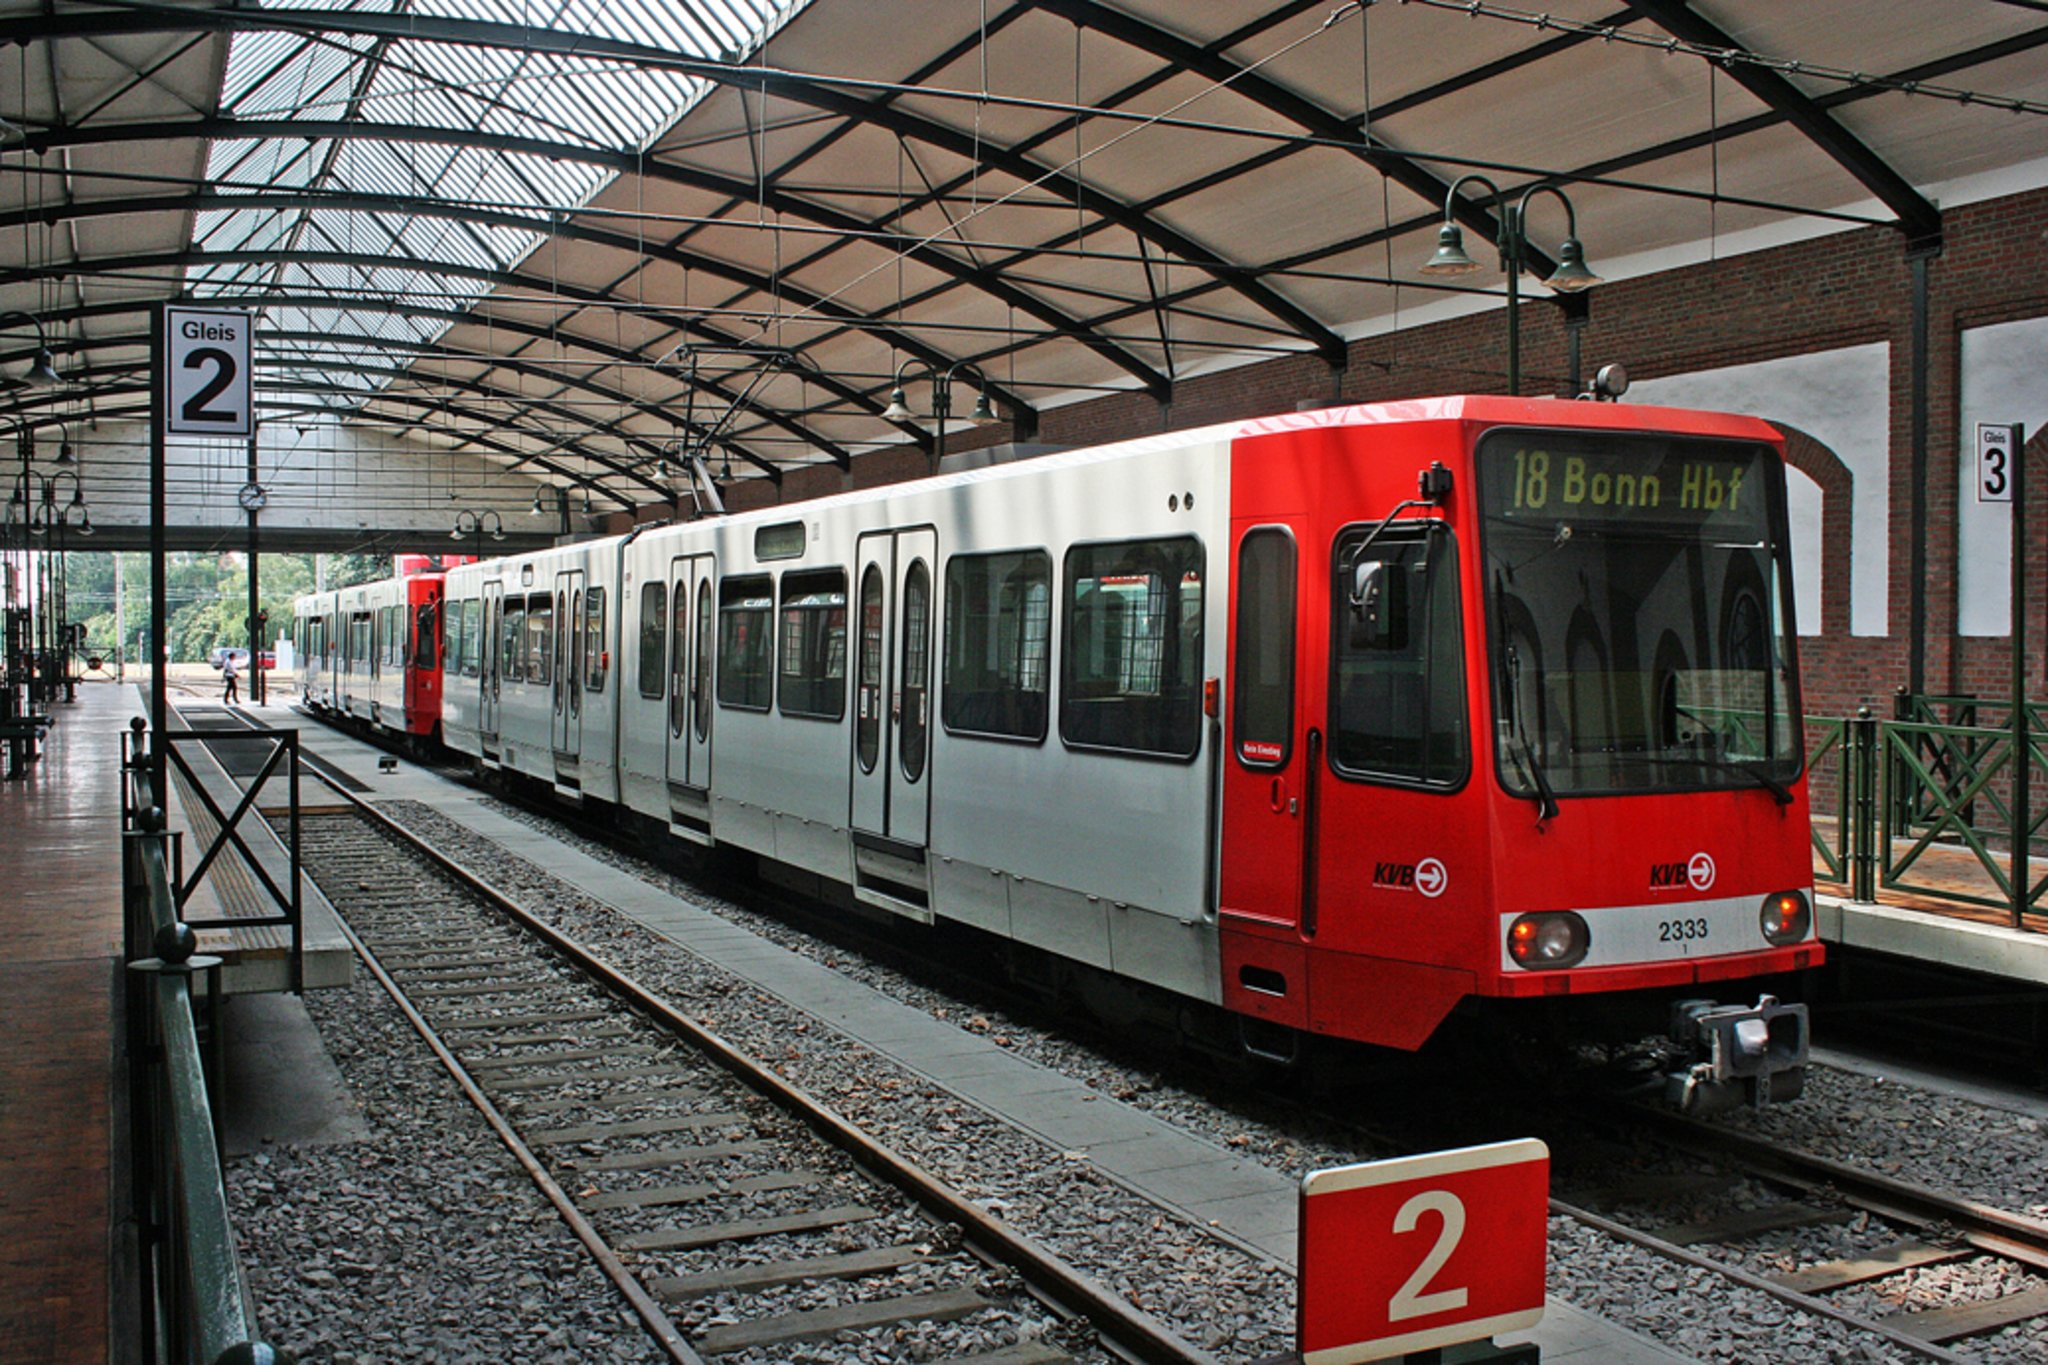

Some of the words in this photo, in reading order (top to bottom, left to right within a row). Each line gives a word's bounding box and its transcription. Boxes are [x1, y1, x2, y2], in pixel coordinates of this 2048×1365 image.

[182, 321, 236, 341] Gleis
[182, 347, 237, 422] 2
[1984, 431, 2006, 443] Gleis
[1514, 450, 1549, 508] 18
[1563, 457, 1660, 507] Bonn
[1680, 464, 1743, 510] Hbf
[1985, 448, 2006, 495] 3
[1373, 862, 1416, 886] KVB
[1650, 863, 1689, 886] KVB
[1659, 918, 1708, 942] 2333
[1388, 1189, 1468, 1323] 2
